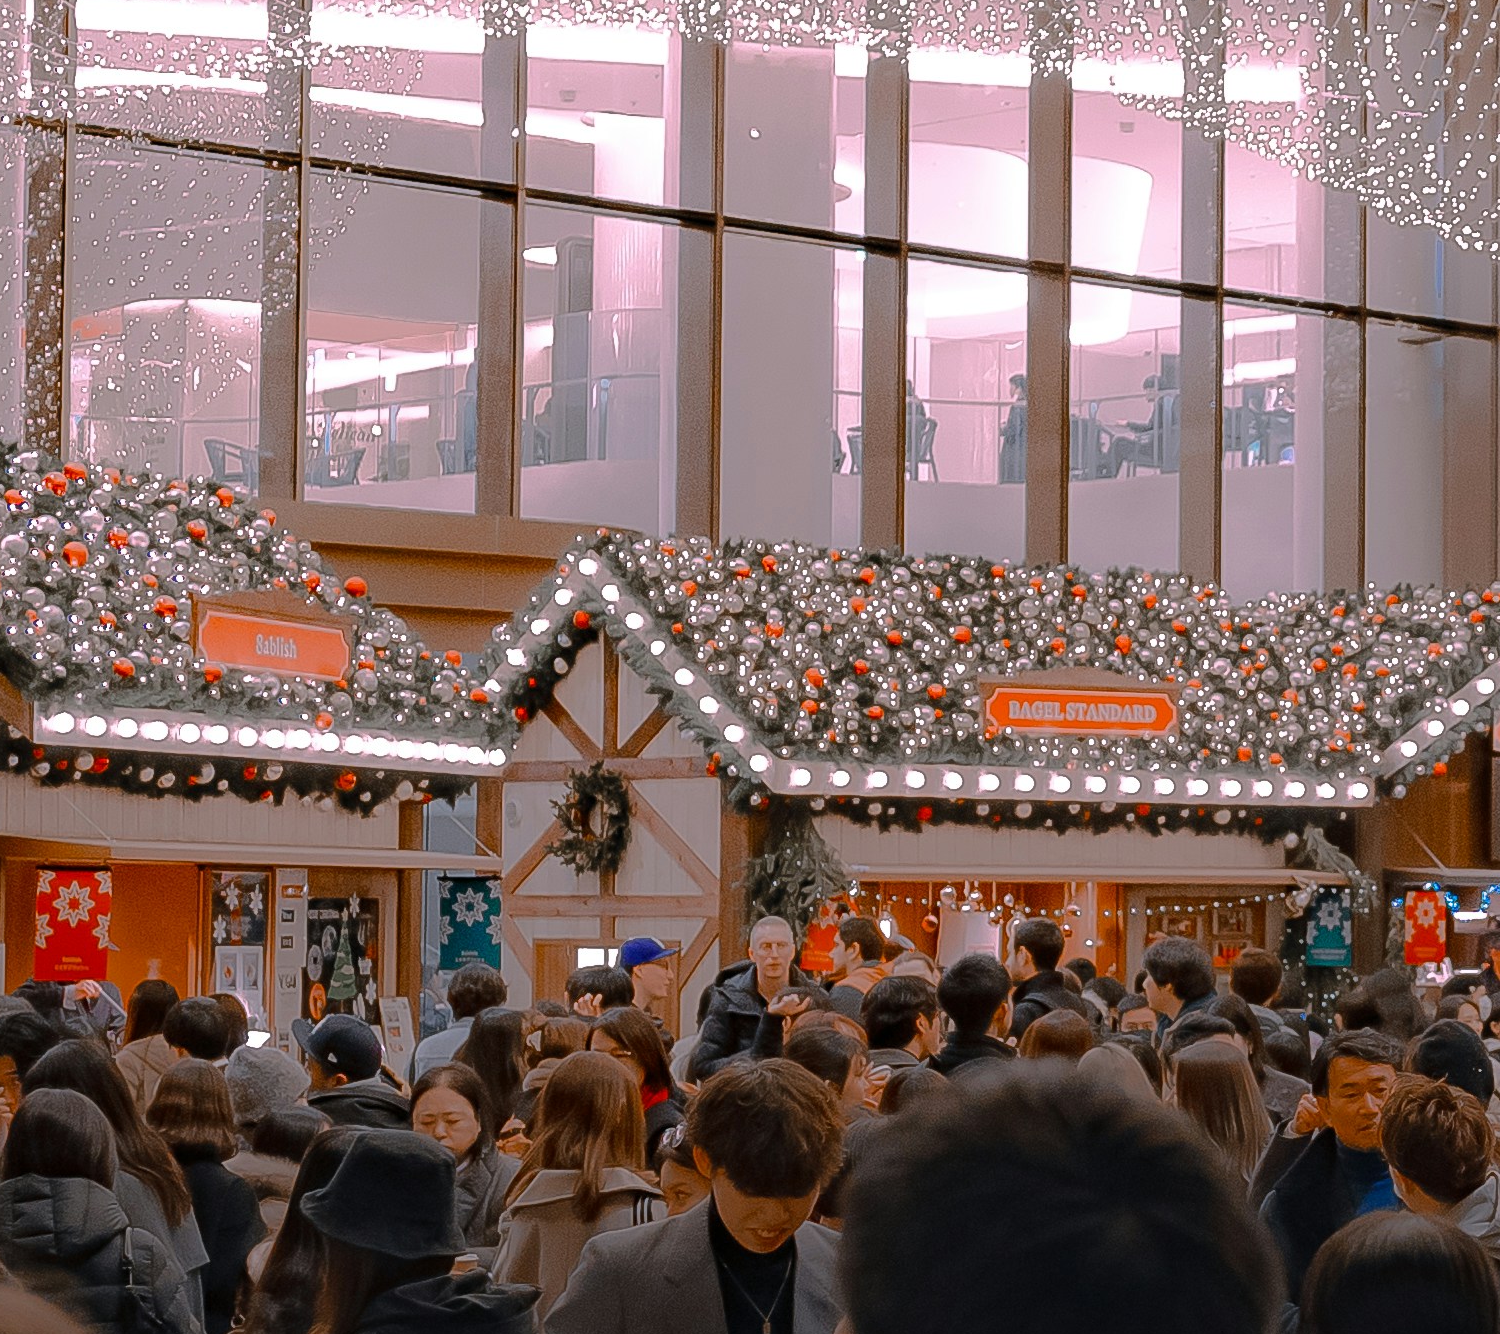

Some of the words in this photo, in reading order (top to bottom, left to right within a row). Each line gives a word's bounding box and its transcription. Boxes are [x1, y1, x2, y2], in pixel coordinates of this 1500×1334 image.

[255, 633, 297, 660] 8ablish
[1008, 700, 1064, 721] BAGEL
[1065, 702, 1158, 724] STANDARD
